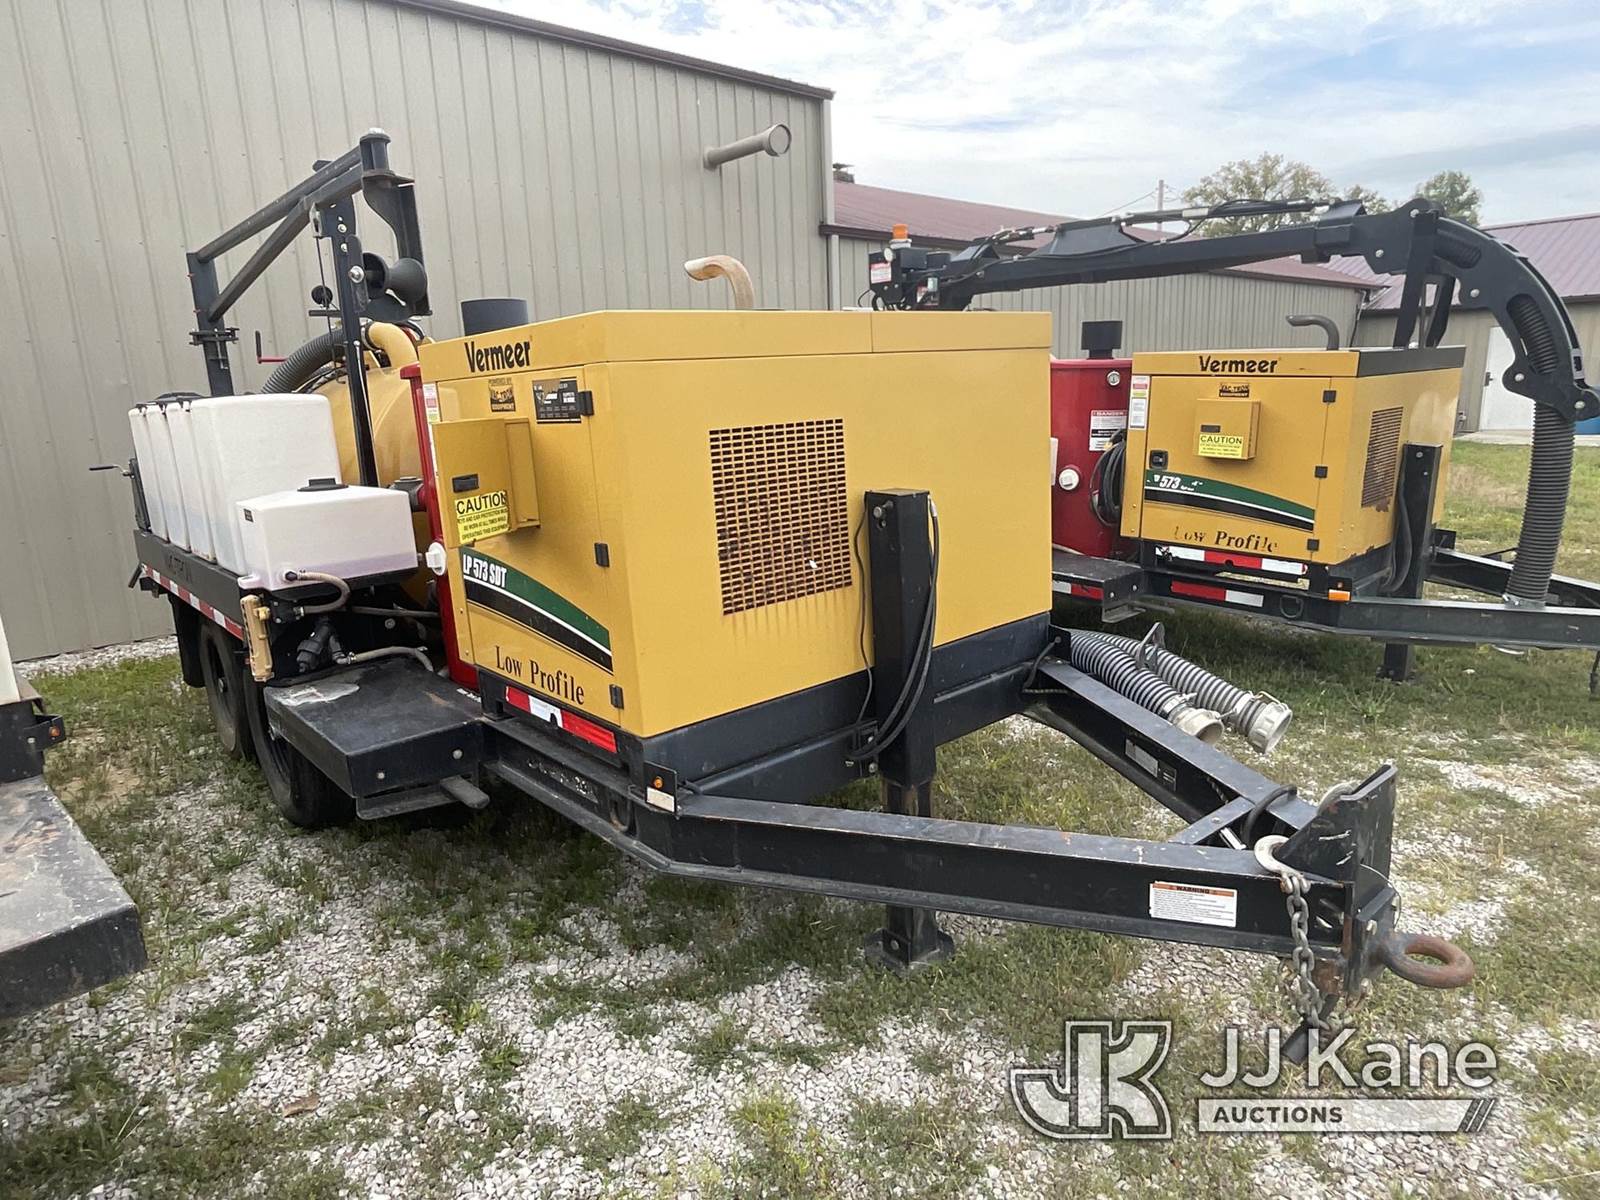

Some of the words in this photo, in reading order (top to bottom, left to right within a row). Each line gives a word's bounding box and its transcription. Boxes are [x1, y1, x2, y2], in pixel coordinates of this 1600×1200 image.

[464, 341, 531, 373] Vermeer
[1199, 355, 1278, 373] Vermeer
[1200, 435, 1242, 444] CAUTION
[1159, 475, 1181, 489] 573
[456, 492, 507, 515] CAUTION
[463, 554, 472, 575] LP
[473, 557, 488, 582] 573
[490, 565, 507, 588] SDT
[495, 645, 523, 677] Low
[530, 659, 585, 705] Profile
[1176, 886, 1210, 894] WARNING
